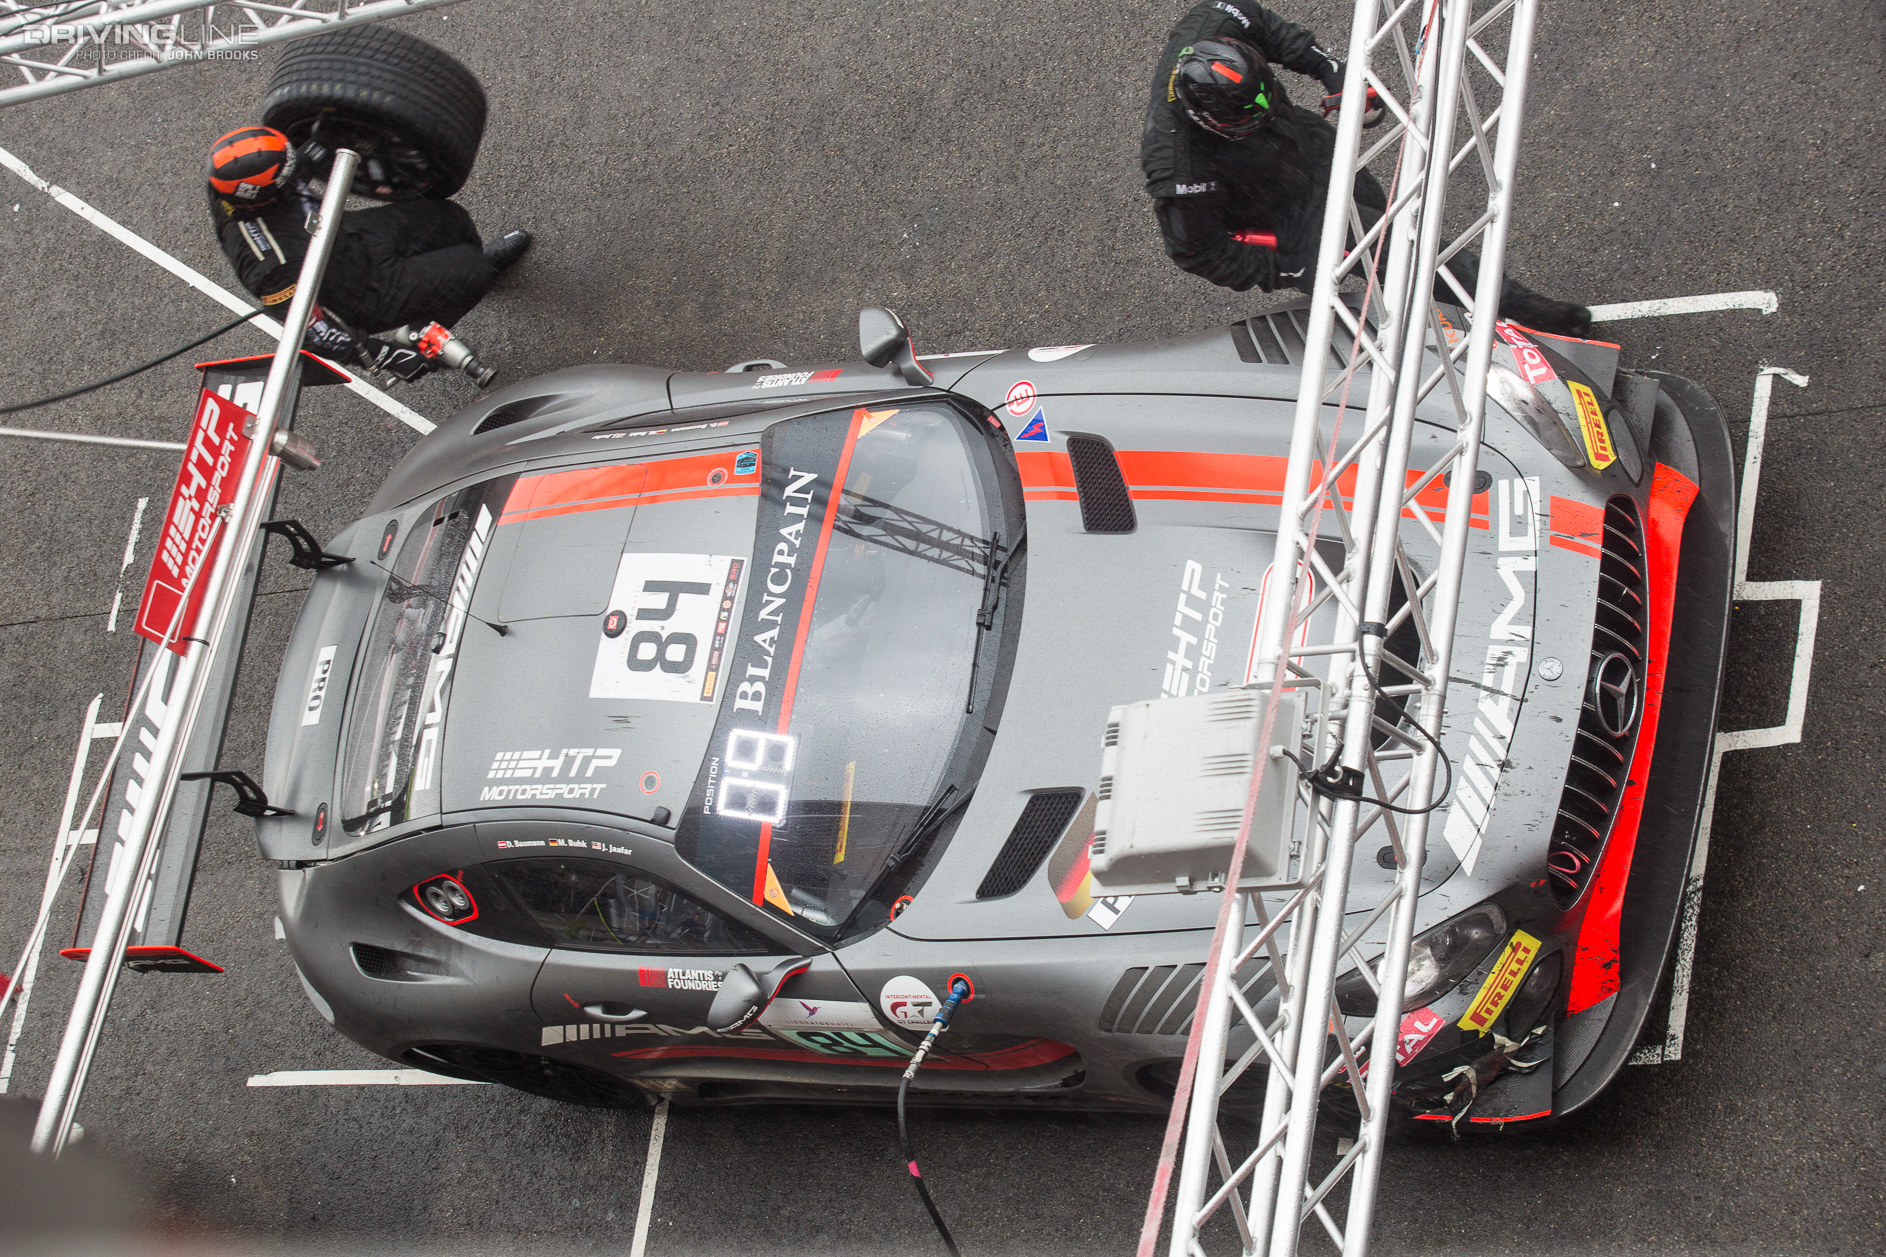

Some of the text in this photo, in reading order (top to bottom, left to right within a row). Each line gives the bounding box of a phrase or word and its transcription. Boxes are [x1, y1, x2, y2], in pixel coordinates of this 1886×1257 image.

[1175, 183, 1208, 195] Mobil
[1576, 388, 1612, 463] PIRELLI
[733, 467, 818, 715] BLANCPAIN
[1478, 476, 1540, 743] AMG
[627, 580, 712, 674] 84
[1194, 572, 1230, 696] ORSPORT
[307, 659, 332, 712] PRO
[479, 783, 607, 801] MOTORSPORT
[703, 756, 720, 815] POSITION
[568, 839, 588, 848] Buhk
[609, 844, 633, 855] Jaafar
[667, 968, 715, 981] ATLANTIS
[667, 978, 723, 992] FOUNDRIES
[1469, 941, 1532, 1028] PIRELLI
[729, 1005, 758, 1031] AMG
[796, 1031, 909, 1056] 84
